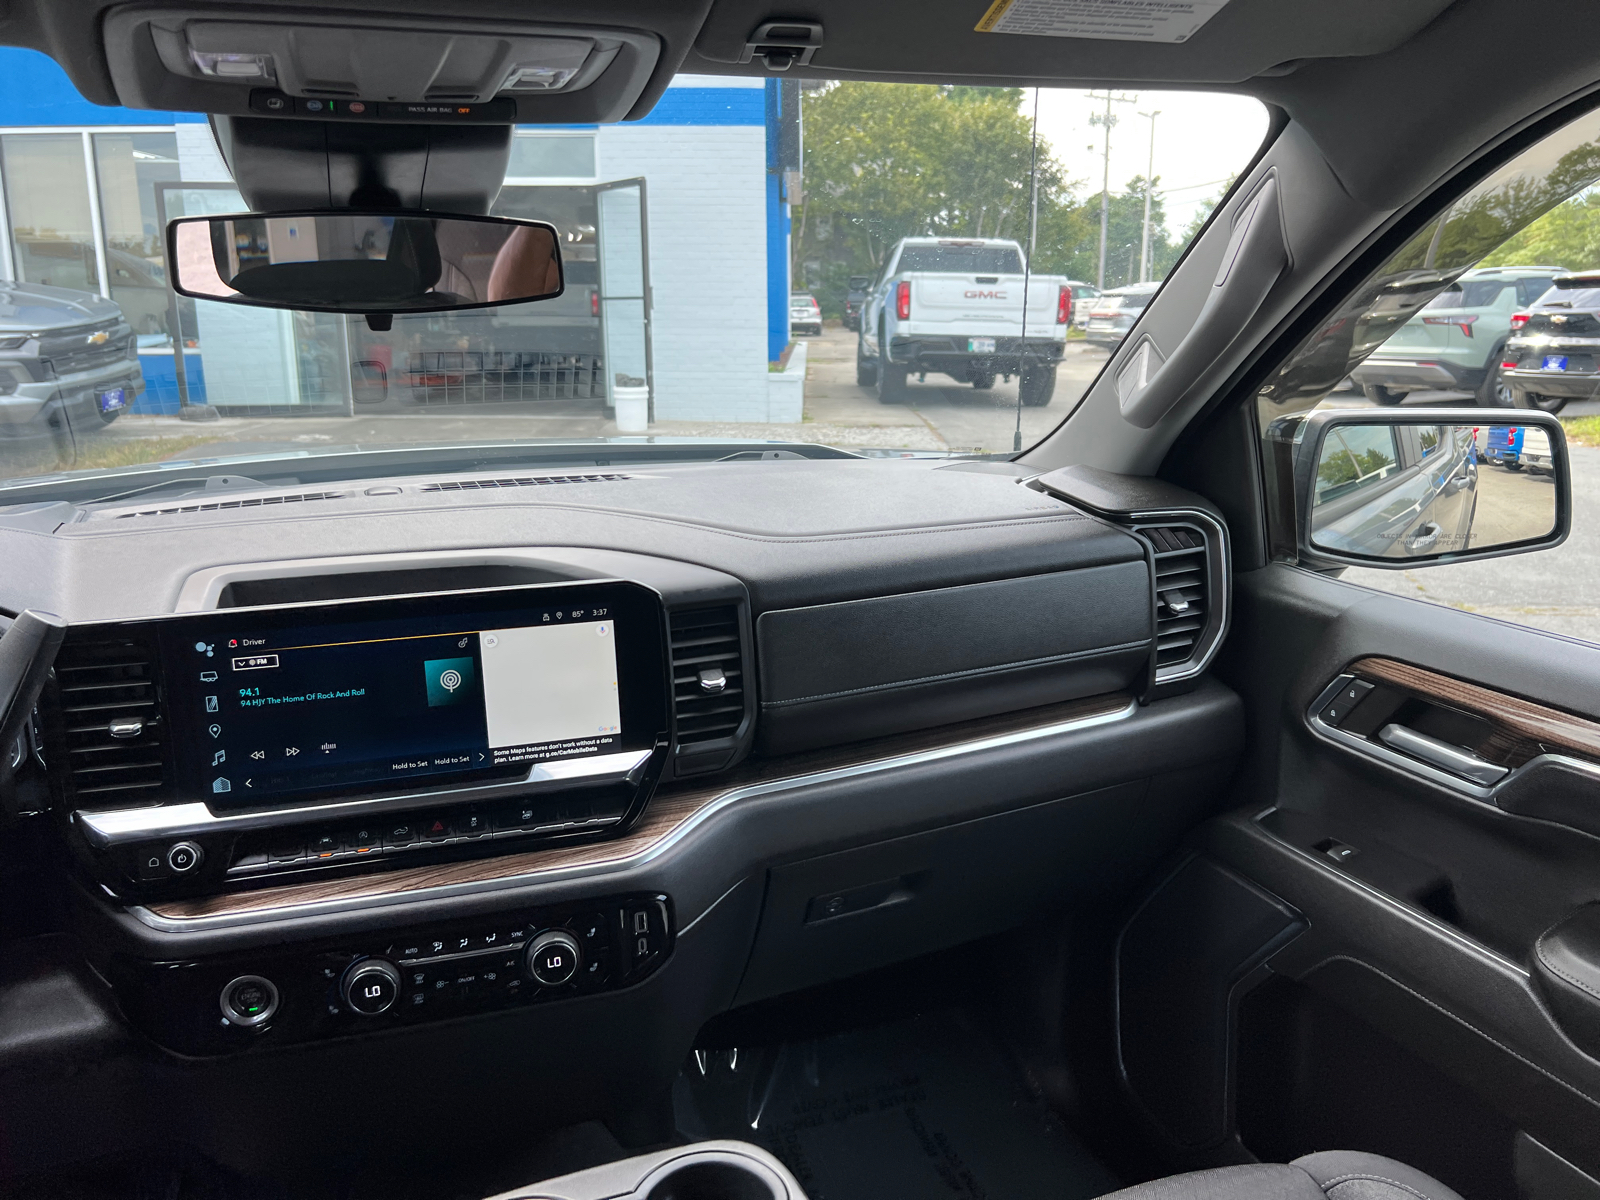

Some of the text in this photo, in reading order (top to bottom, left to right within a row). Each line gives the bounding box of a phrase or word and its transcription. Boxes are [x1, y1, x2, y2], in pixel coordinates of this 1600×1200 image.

[964, 290, 1007, 299] GMC
[592, 608, 607, 617] 3:37
[243, 638, 266, 647] Driver
[239, 687, 260, 698] 94.1
[240, 699, 251, 708] 94
[252, 698, 266, 707] HJY
[282, 695, 305, 703] Home
[306, 692, 316, 701] Of
[317, 691, 335, 700] Rock
[335, 689, 350, 698] And
[351, 688, 366, 696] Roll
[493, 749, 510, 757] Some
[510, 747, 526, 755] Maps
[526, 745, 548, 753] features
[548, 743, 563, 751] don't
[563, 741, 575, 749] work
[575, 740, 596, 748] without
[392, 762, 408, 770] Hold
[434, 757, 450, 765] Hold
[547, 956, 562, 968] LO
[365, 985, 381, 998] LO
